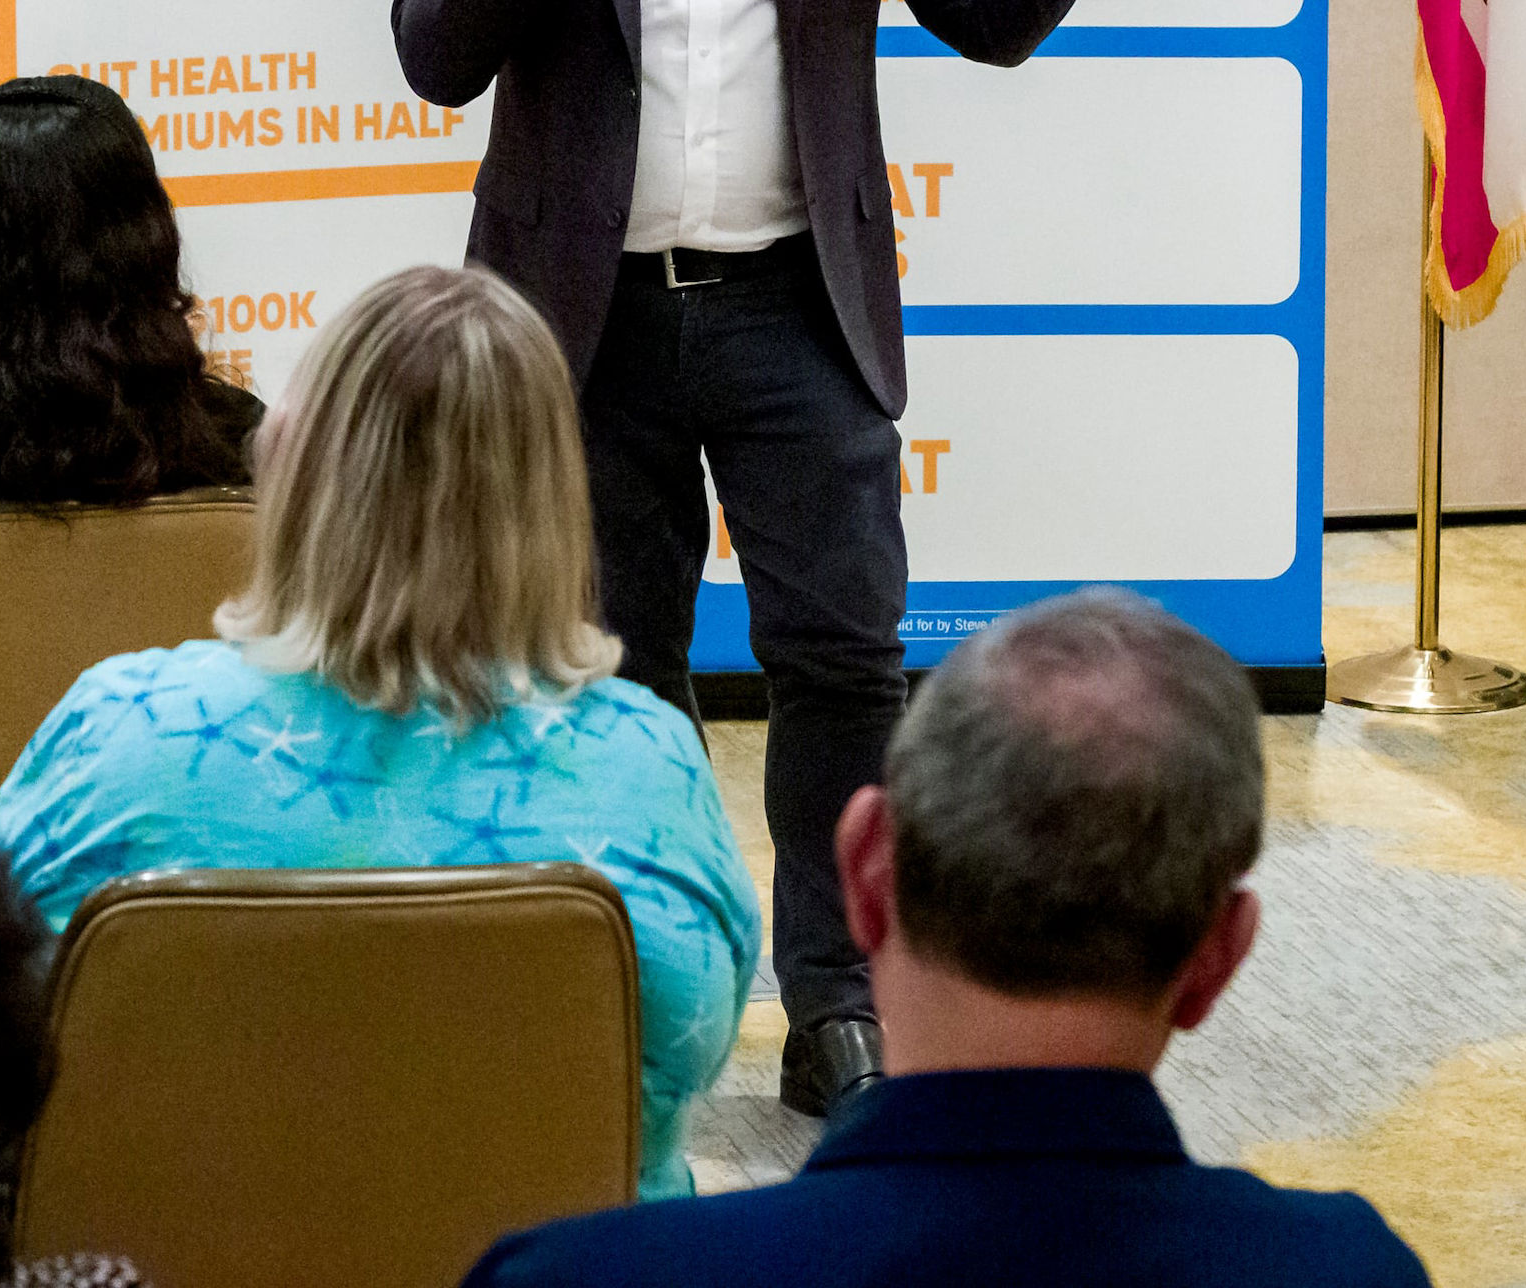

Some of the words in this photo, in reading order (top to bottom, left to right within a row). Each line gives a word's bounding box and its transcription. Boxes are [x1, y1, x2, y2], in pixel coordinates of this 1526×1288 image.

[150, 51, 317, 98] HEALTH
[138, 106, 284, 152] MIUMS
[297, 105, 340, 144] IN
[354, 101, 465, 141] HALF
[916, 618, 934, 632] for
[937, 619, 951, 633] by
[955, 617, 988, 632] Steve
